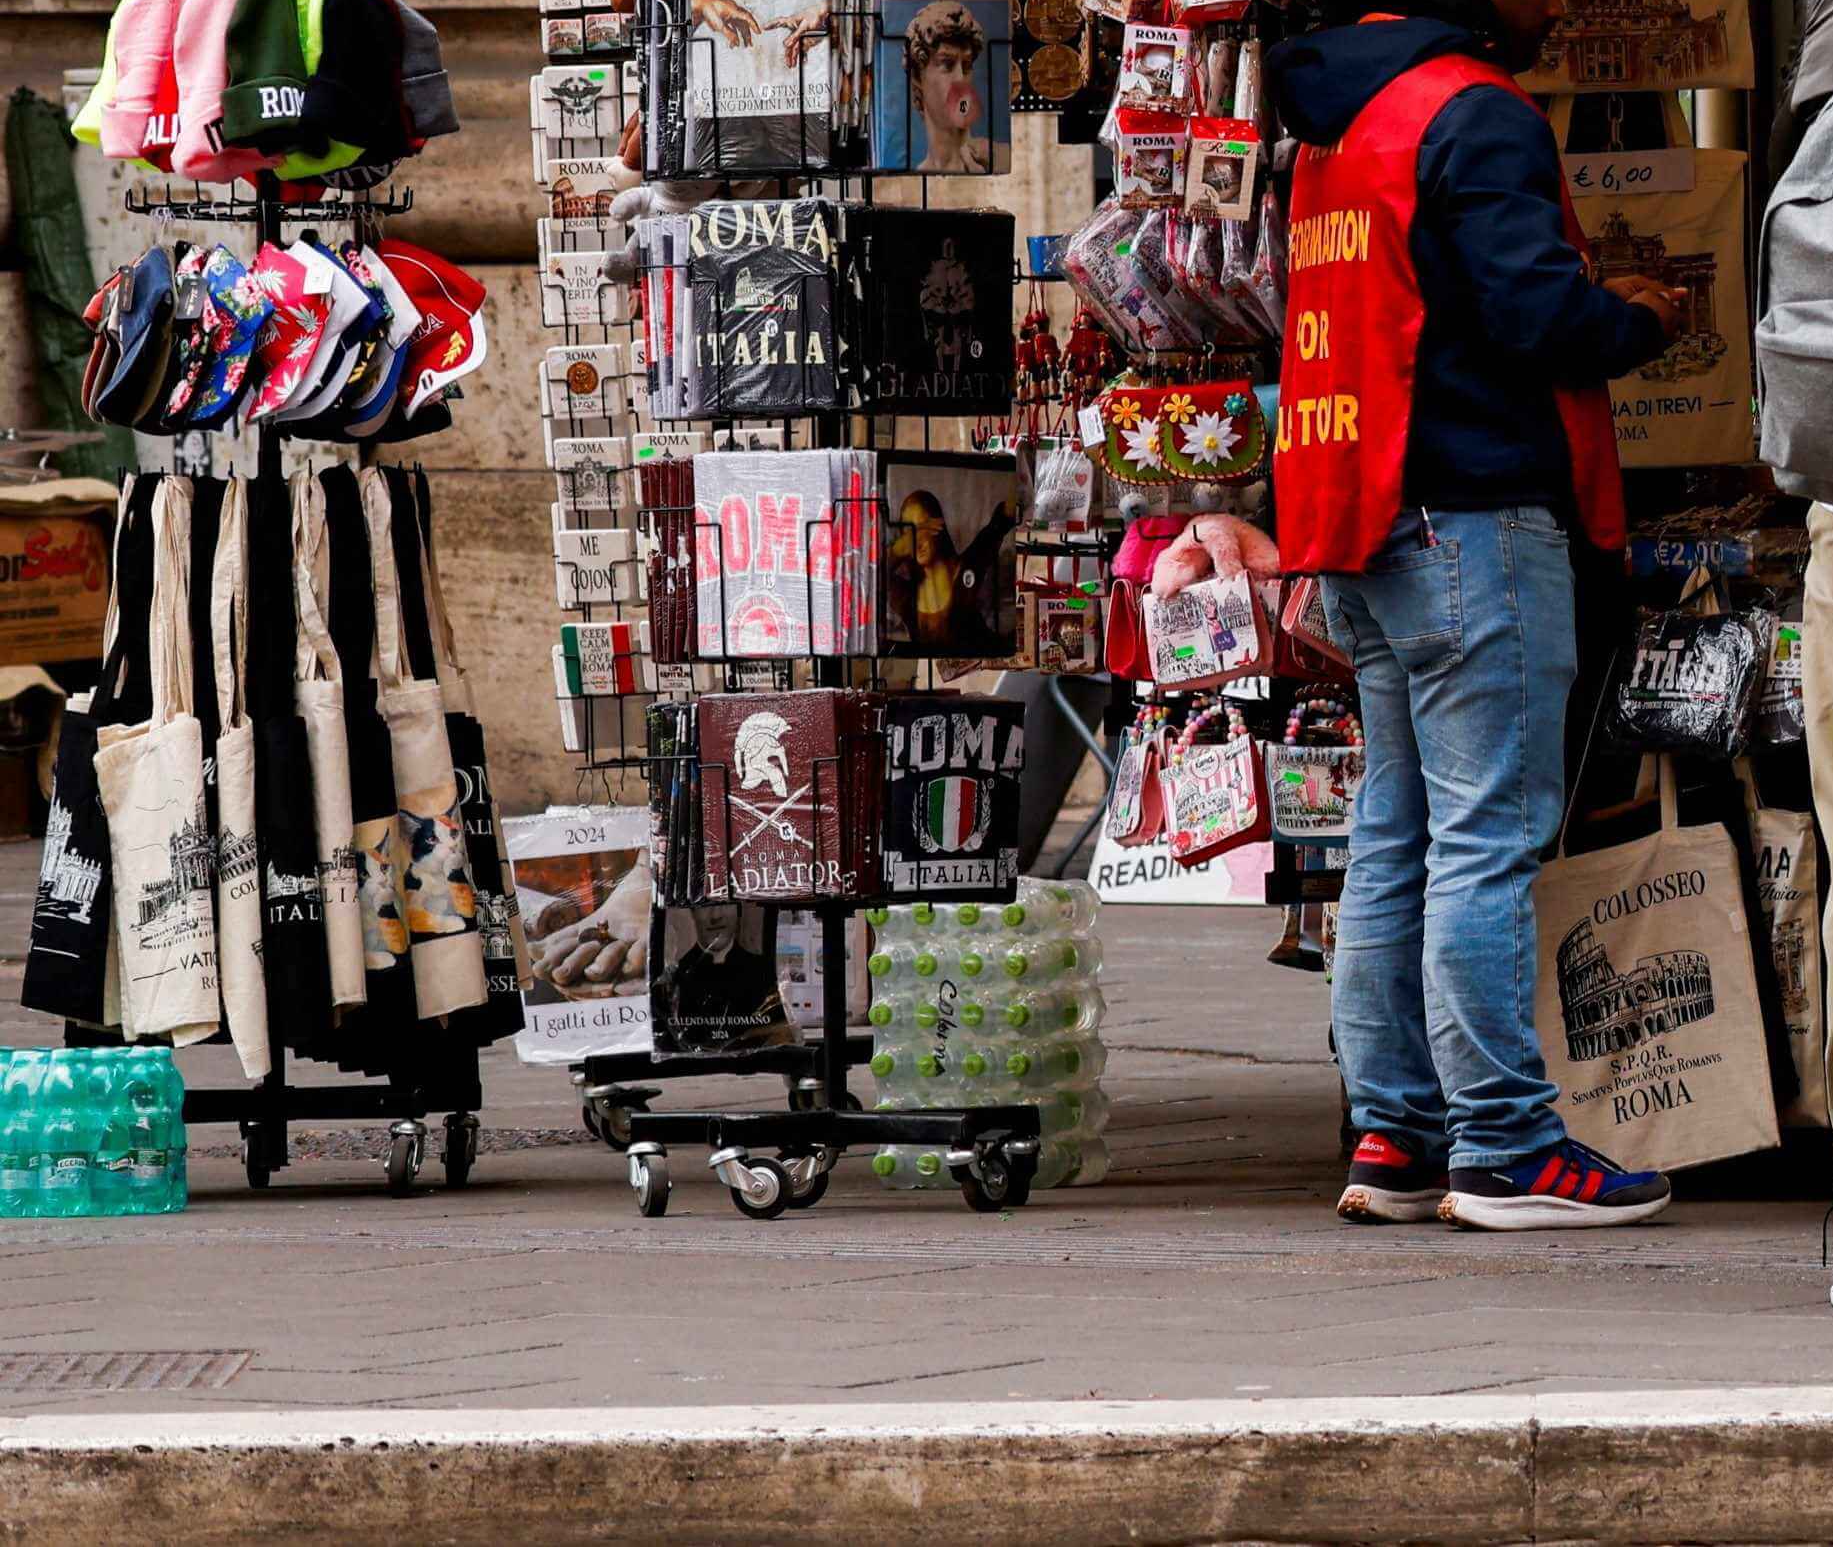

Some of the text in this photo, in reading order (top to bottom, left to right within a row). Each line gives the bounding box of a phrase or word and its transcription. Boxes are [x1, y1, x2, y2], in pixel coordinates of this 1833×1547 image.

[1135, 29, 1178, 42] ROMA
[1132, 134, 1175, 148] ROMA
[559, 163, 606, 175] ROMA
[567, 276, 597, 287] VINO
[565, 351, 598, 361] ROMA
[1654, 397, 1702, 415] TREVI
[649, 434, 689, 446] ROMA
[571, 443, 605, 454] ROMA
[579, 536, 600, 556] ME
[581, 629, 608, 639] KEEP
[580, 639, 609, 648] CALM
[582, 654, 609, 663] LOVE
[582, 663, 612, 672] ROMA
[565, 825, 607, 846] 2024
[908, 864, 993, 887] ITALIA
[1593, 867, 1706, 927] COLOSSEO
[667, 1014, 771, 1027] CALENDARIO ROMANO
[1609, 1044, 1674, 1076] S.P.Q.R.
[1612, 1084, 1694, 1126] ROMA
